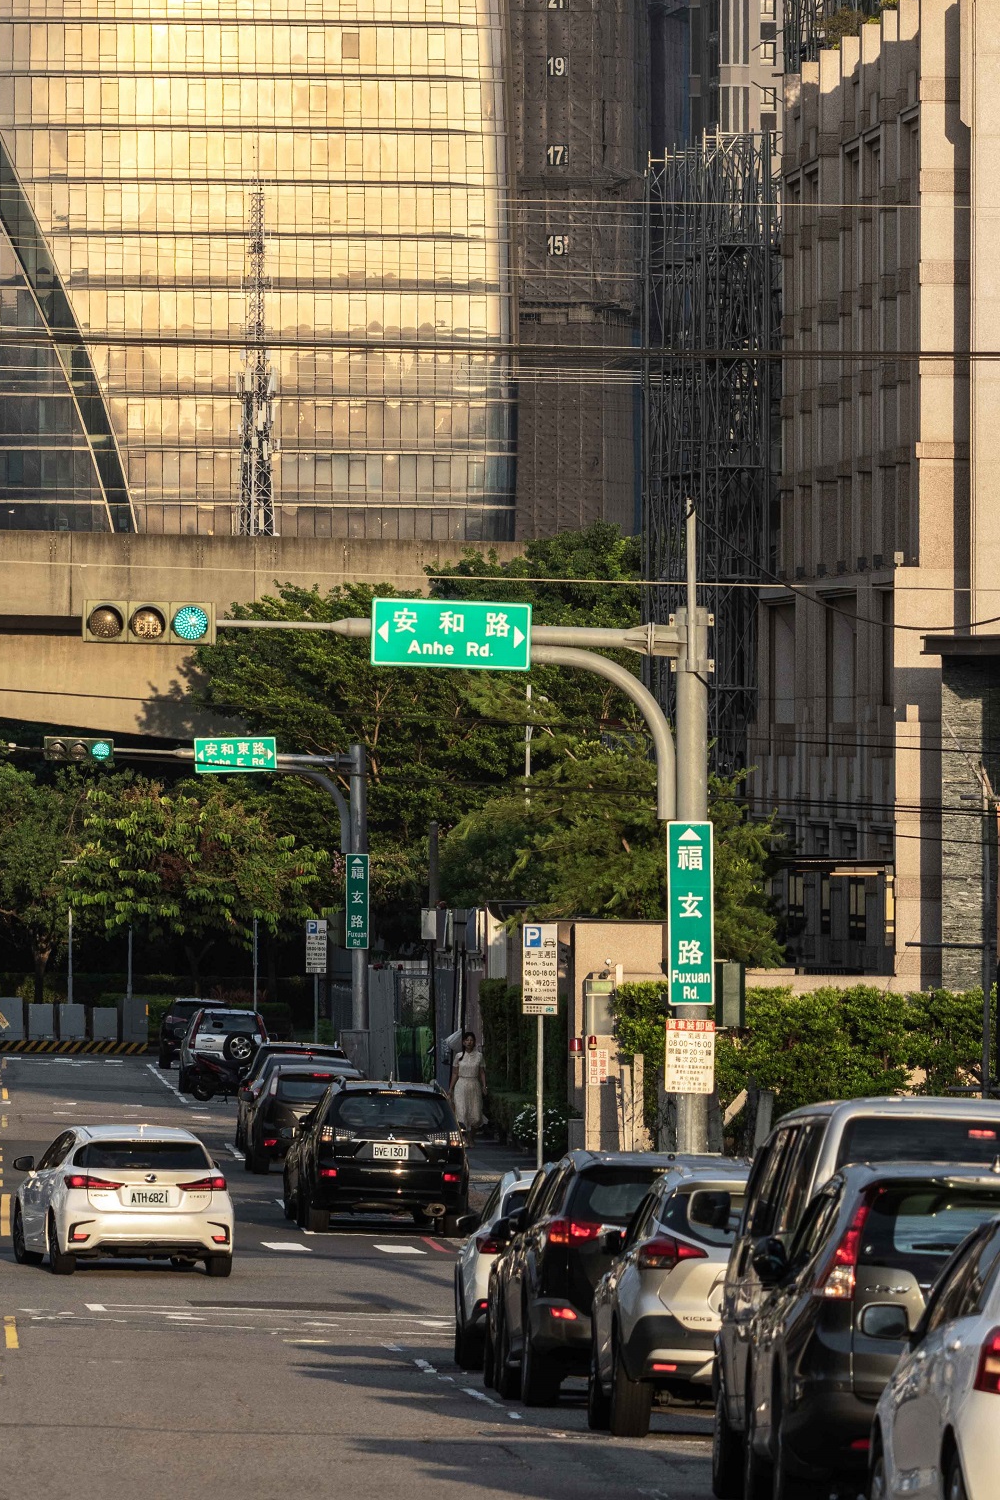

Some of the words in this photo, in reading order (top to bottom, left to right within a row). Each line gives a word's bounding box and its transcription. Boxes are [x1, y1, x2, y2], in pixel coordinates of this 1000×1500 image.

[547, 57, 564, 77] 19
[547, 145, 564, 166] 17
[547, 236, 564, 256] 15
[393, 608, 511, 638] 安和路
[407, 640, 455, 655] Anhe
[466, 641, 494, 657] Rd.
[204, 742, 266, 756] 安和東路
[252, 757, 267, 766] Rd.
[350, 866, 365, 928] 福玄路
[677, 845, 704, 965] 福玄路
[526, 928, 540, 946] P
[672, 969, 711, 985] Fuxuan
[682, 986, 700, 1000] Rd.
[374, 1147, 407, 1157] BVE-1301
[131, 1192, 169, 1203] ATH-6821
